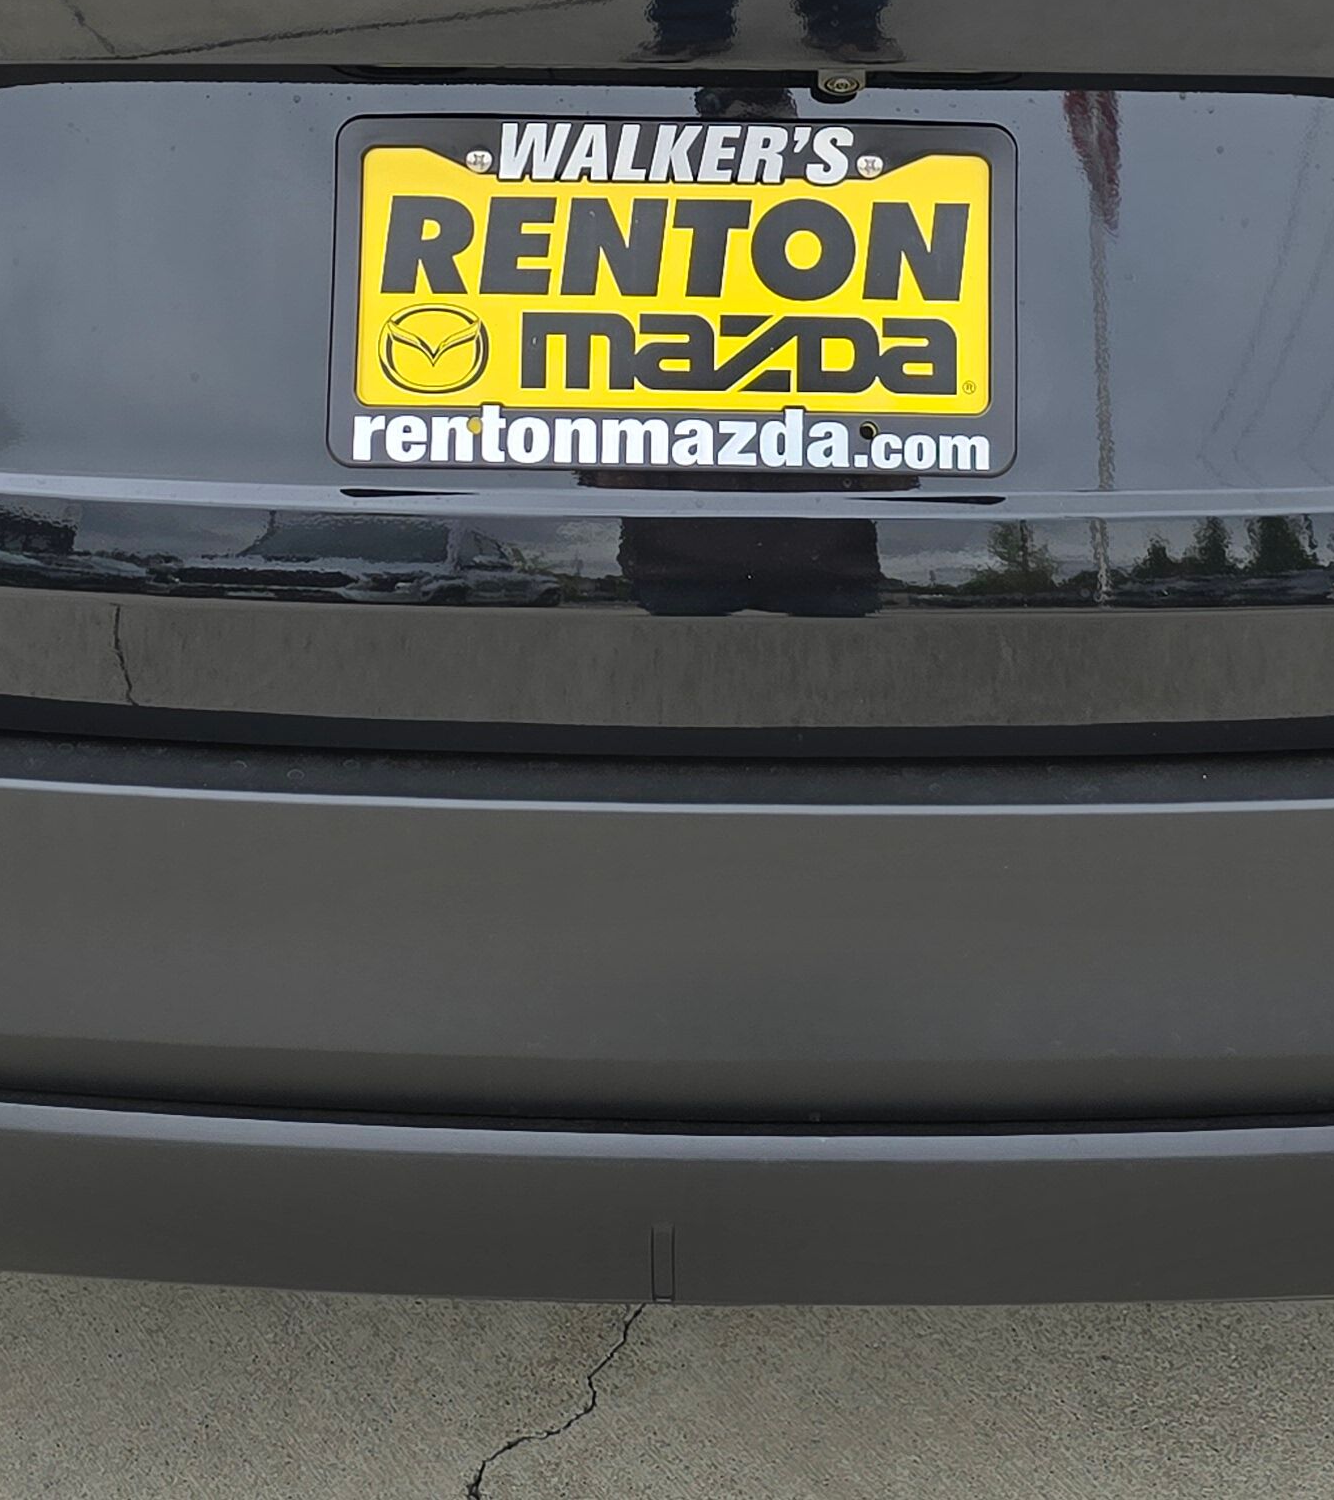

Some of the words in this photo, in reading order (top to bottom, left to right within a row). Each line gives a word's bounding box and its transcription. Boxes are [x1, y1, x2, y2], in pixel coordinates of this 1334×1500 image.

[496, 121, 855, 185] WALKER'S
[380, 195, 971, 301] RENTON
[351, 404, 991, 470] rentonmazda.com
